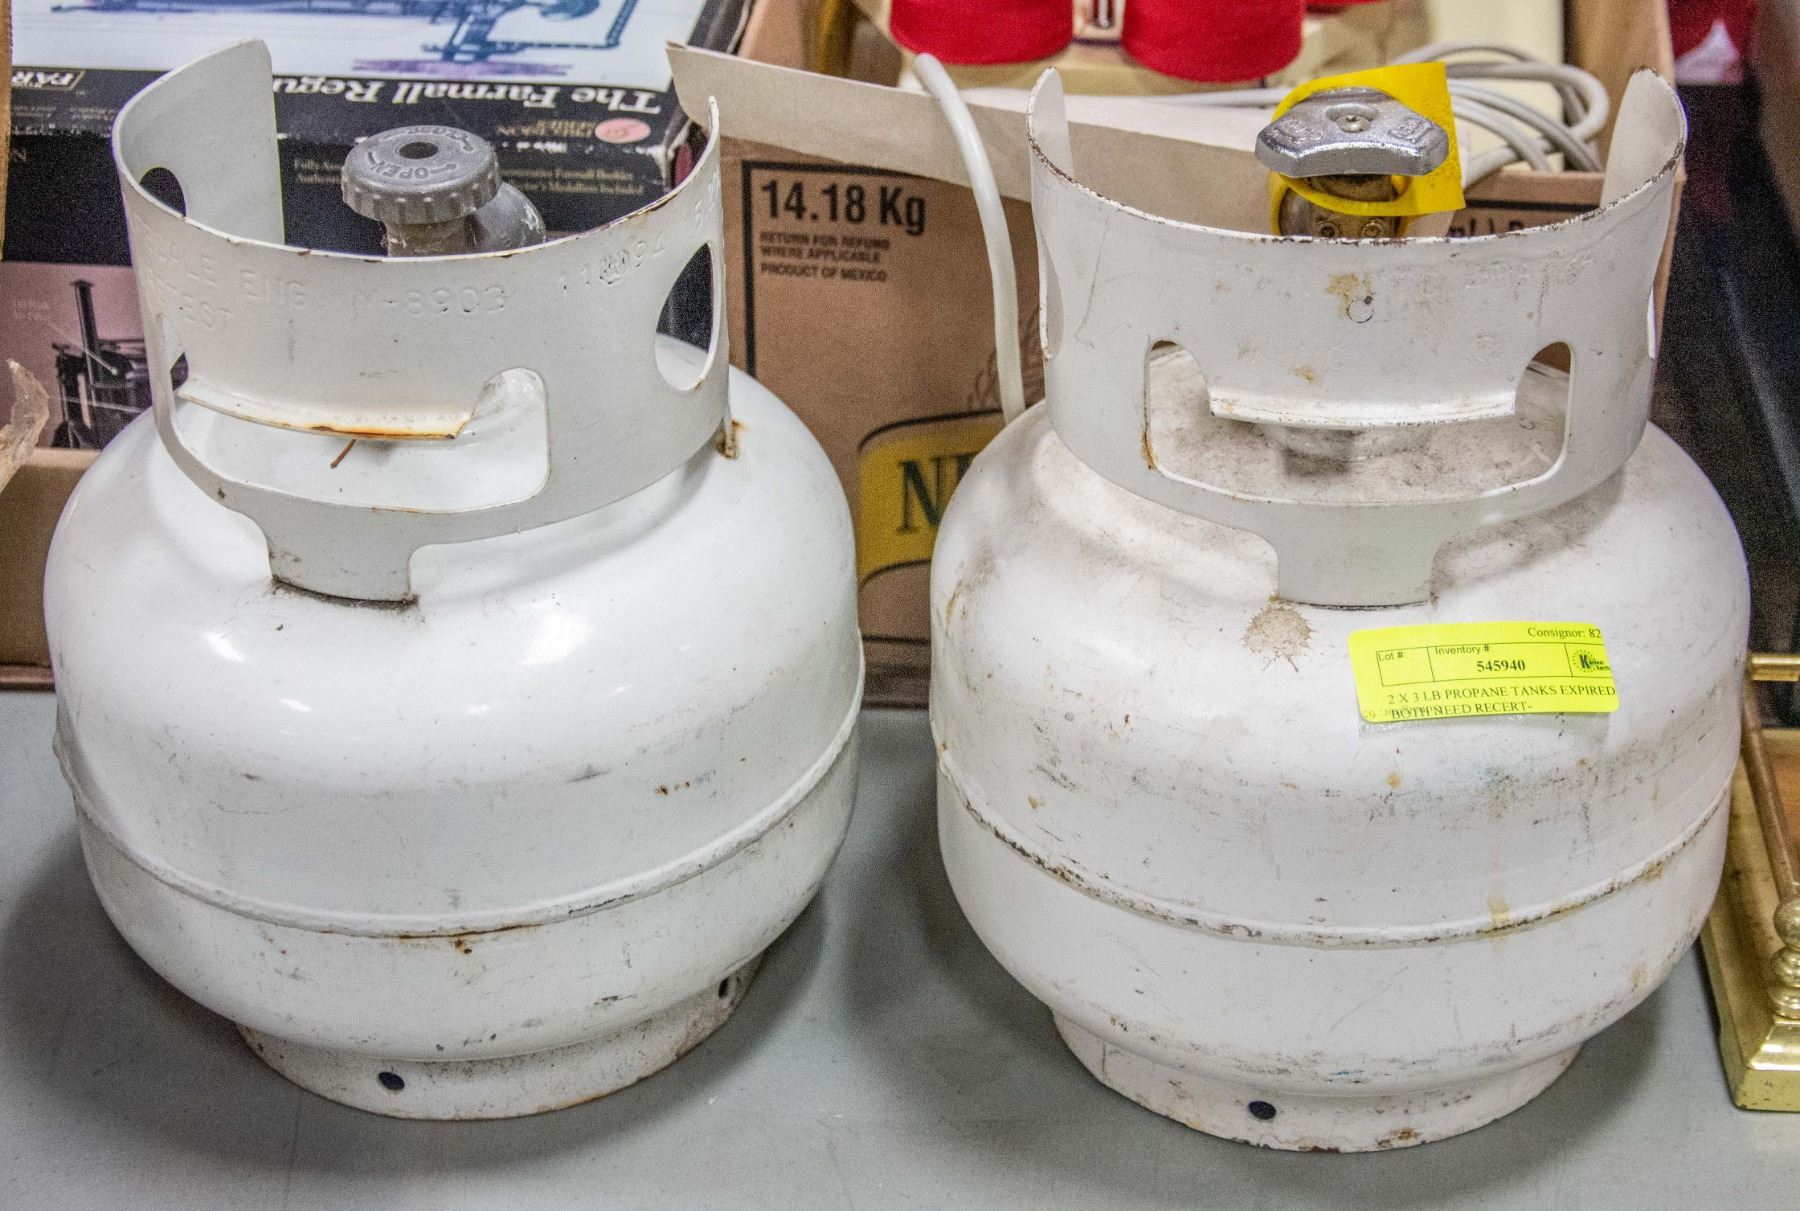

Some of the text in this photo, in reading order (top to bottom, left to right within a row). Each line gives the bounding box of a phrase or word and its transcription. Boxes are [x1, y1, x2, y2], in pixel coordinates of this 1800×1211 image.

[272, 75, 662, 114] The Farmall Regu
[371, 160, 429, 180] OPEN
[761, 179, 866, 224] 14.18
[879, 186, 926, 236] Kg
[760, 230, 891, 250] RETURN FOR REFUND
[760, 245, 881, 263] WHERE APPLICABLE
[760, 262, 888, 282] PRODUCT OF MEXICO
[896, 452, 974, 535] N
[1527, 626, 1587, 640] Consignor:
[1378, 652, 1394, 662] Lot
[1434, 645, 1481, 656] Inventory
[1476, 659, 1527, 673] 545940
[1387, 685, 1617, 705] 2 X 3 LB PROPANE TANKS EXPIRED
[1433, 703, 1472, 716] NEED
[1474, 701, 1533, 714] RECERT-
